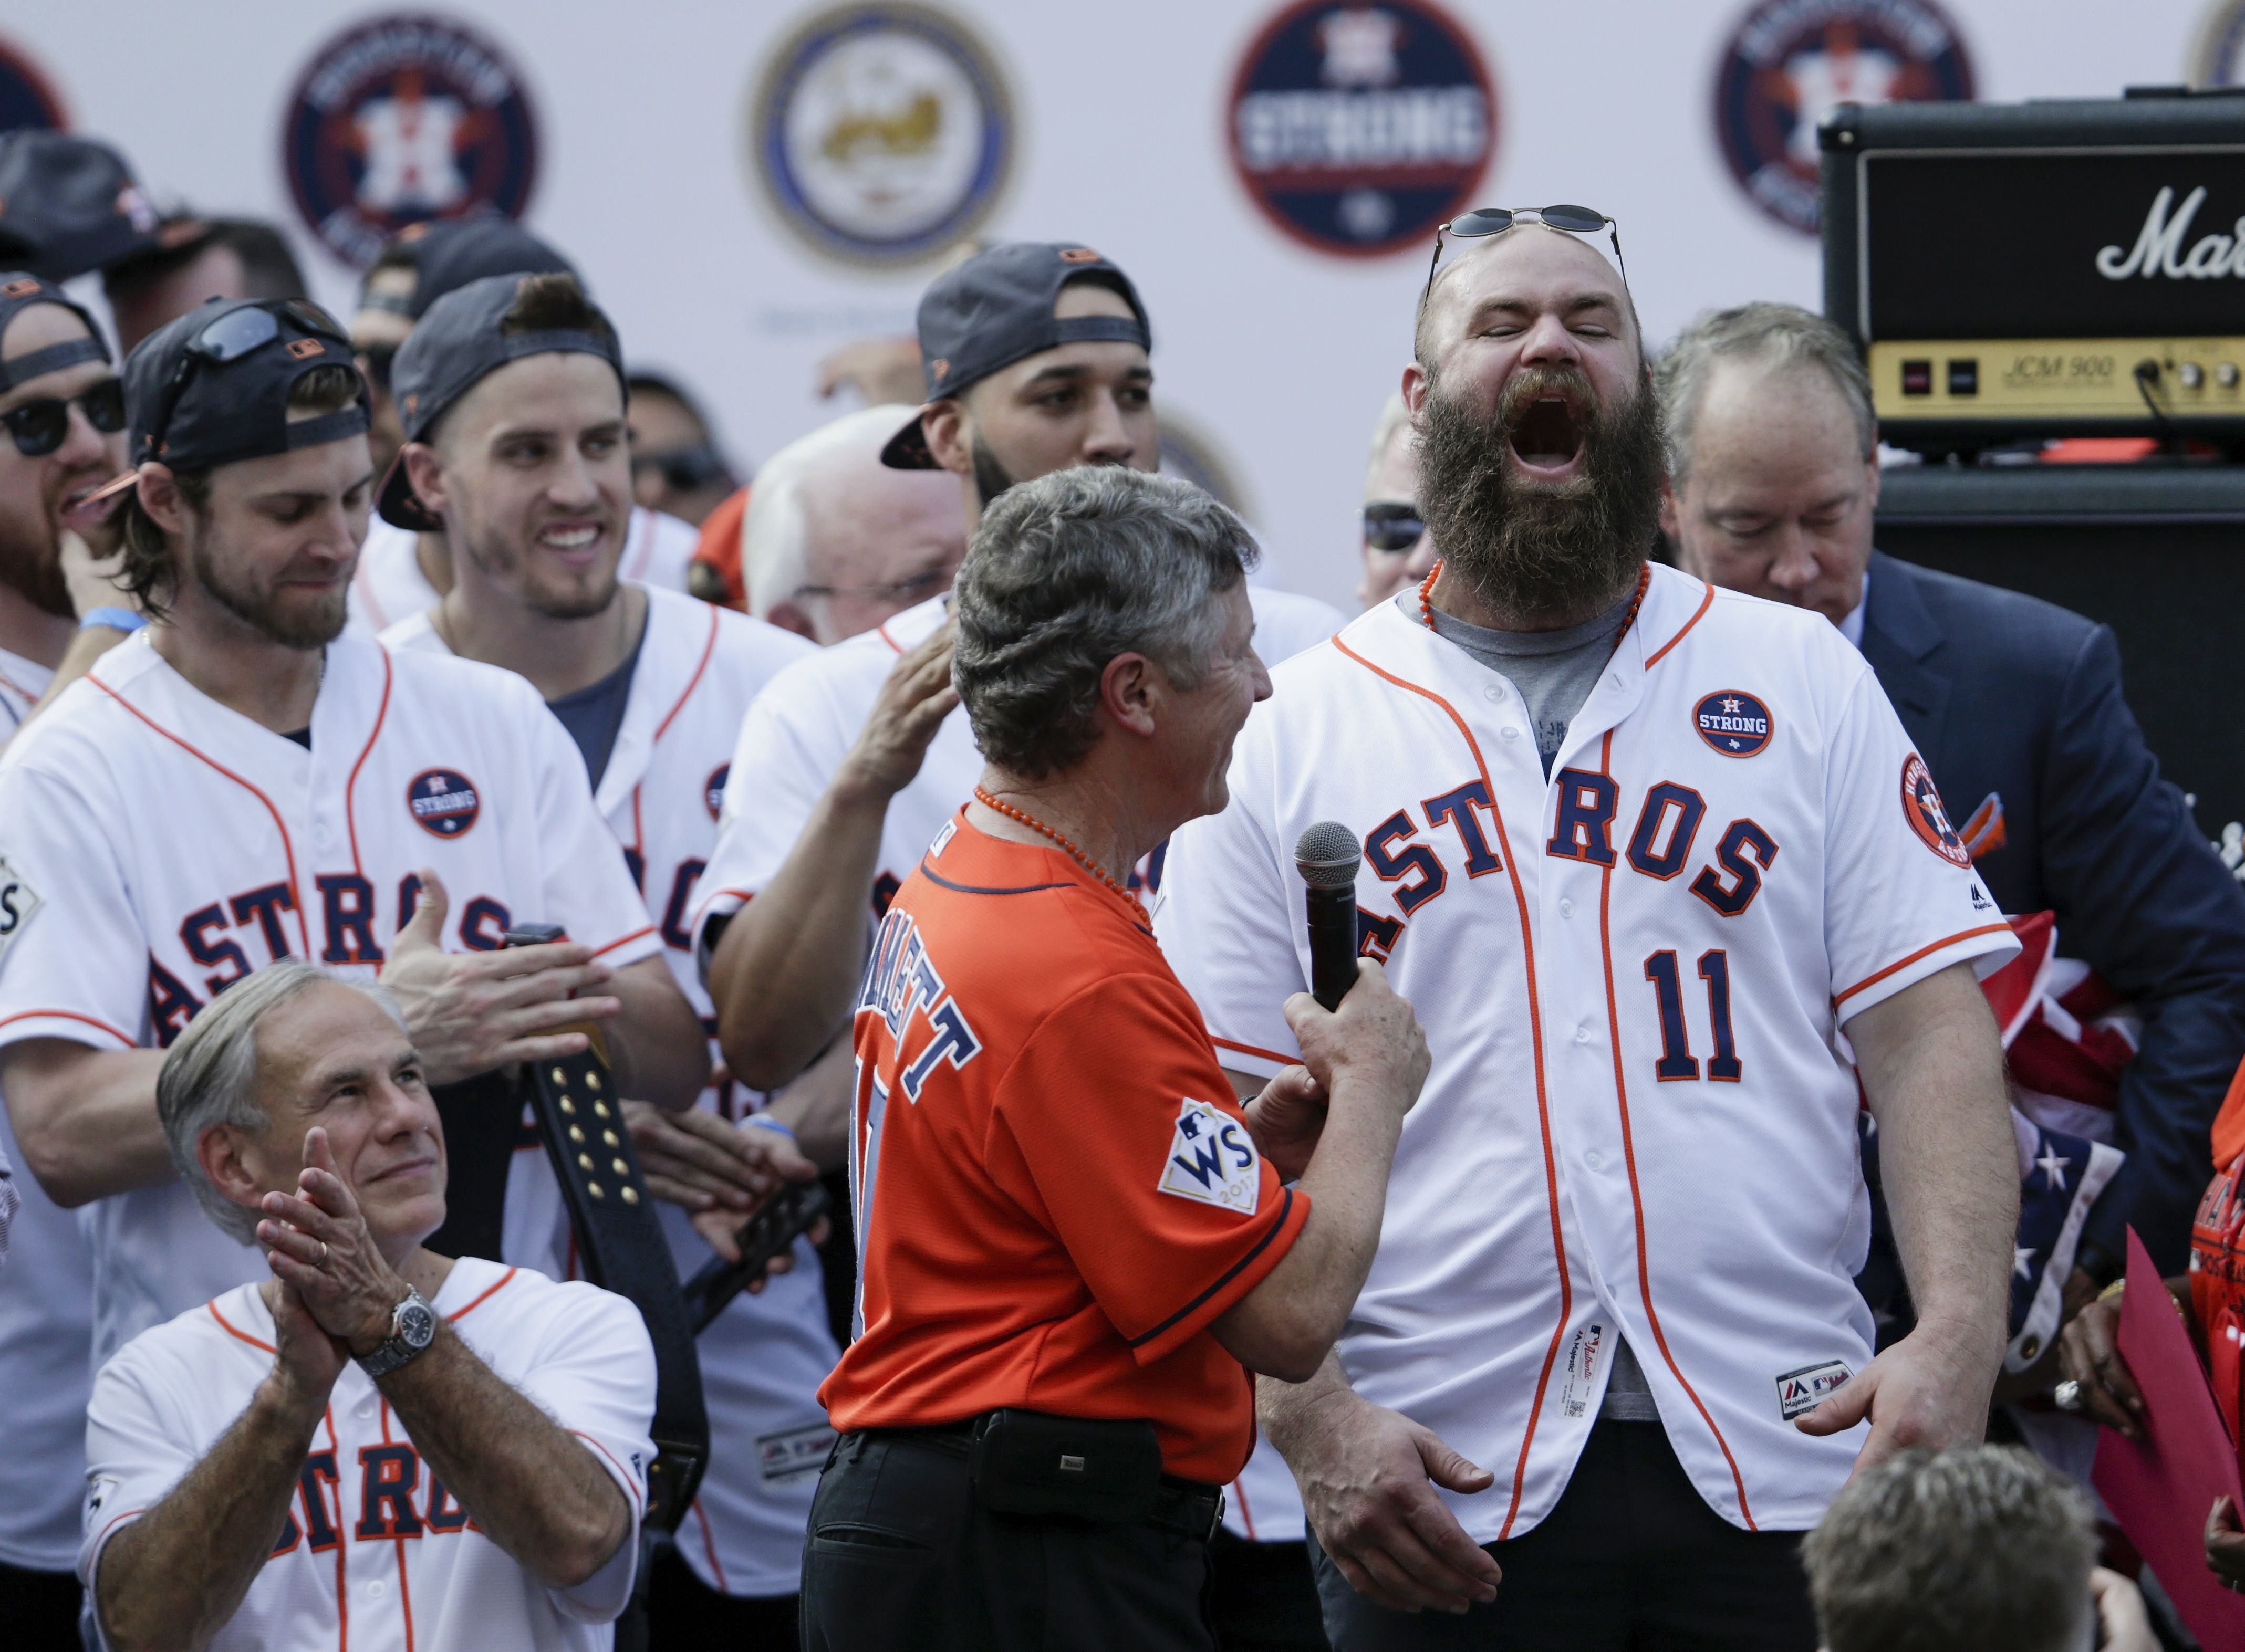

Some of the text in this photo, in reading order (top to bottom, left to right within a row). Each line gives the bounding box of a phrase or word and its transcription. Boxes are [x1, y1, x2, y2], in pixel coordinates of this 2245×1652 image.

[2002, 355, 2116, 378] JCM 900
[1699, 714, 1766, 733] STRONG
[412, 789, 477, 817] STRONG
[1644, 949, 1742, 1082] 11
[1173, 1124, 1255, 1191] WS
[1568, 1342, 1580, 1372] Majestic
[1584, 1342, 1596, 1380] Authentic
[1785, 1395, 1812, 1409] Majestic
